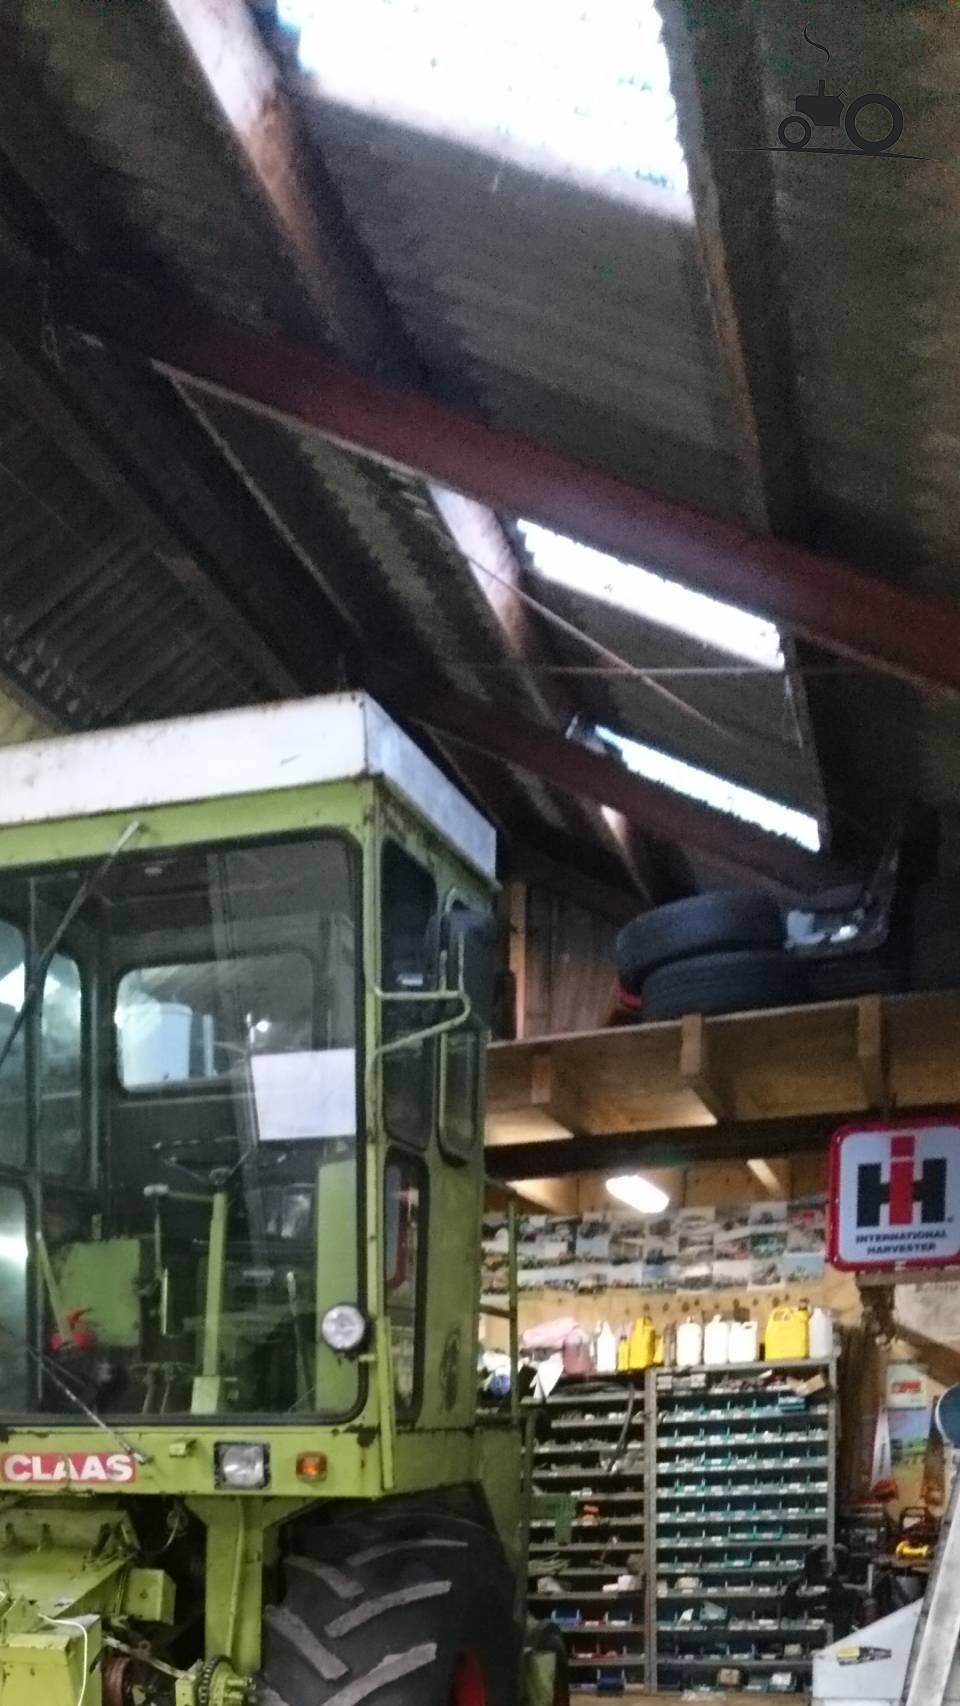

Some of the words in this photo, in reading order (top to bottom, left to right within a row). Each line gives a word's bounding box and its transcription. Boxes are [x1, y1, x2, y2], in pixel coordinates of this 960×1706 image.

[856, 1230, 947, 1243] INTERNATIONAL
[867, 1243, 936, 1255] HARVESTER
[4, 1454, 134, 1481] CLAAS
